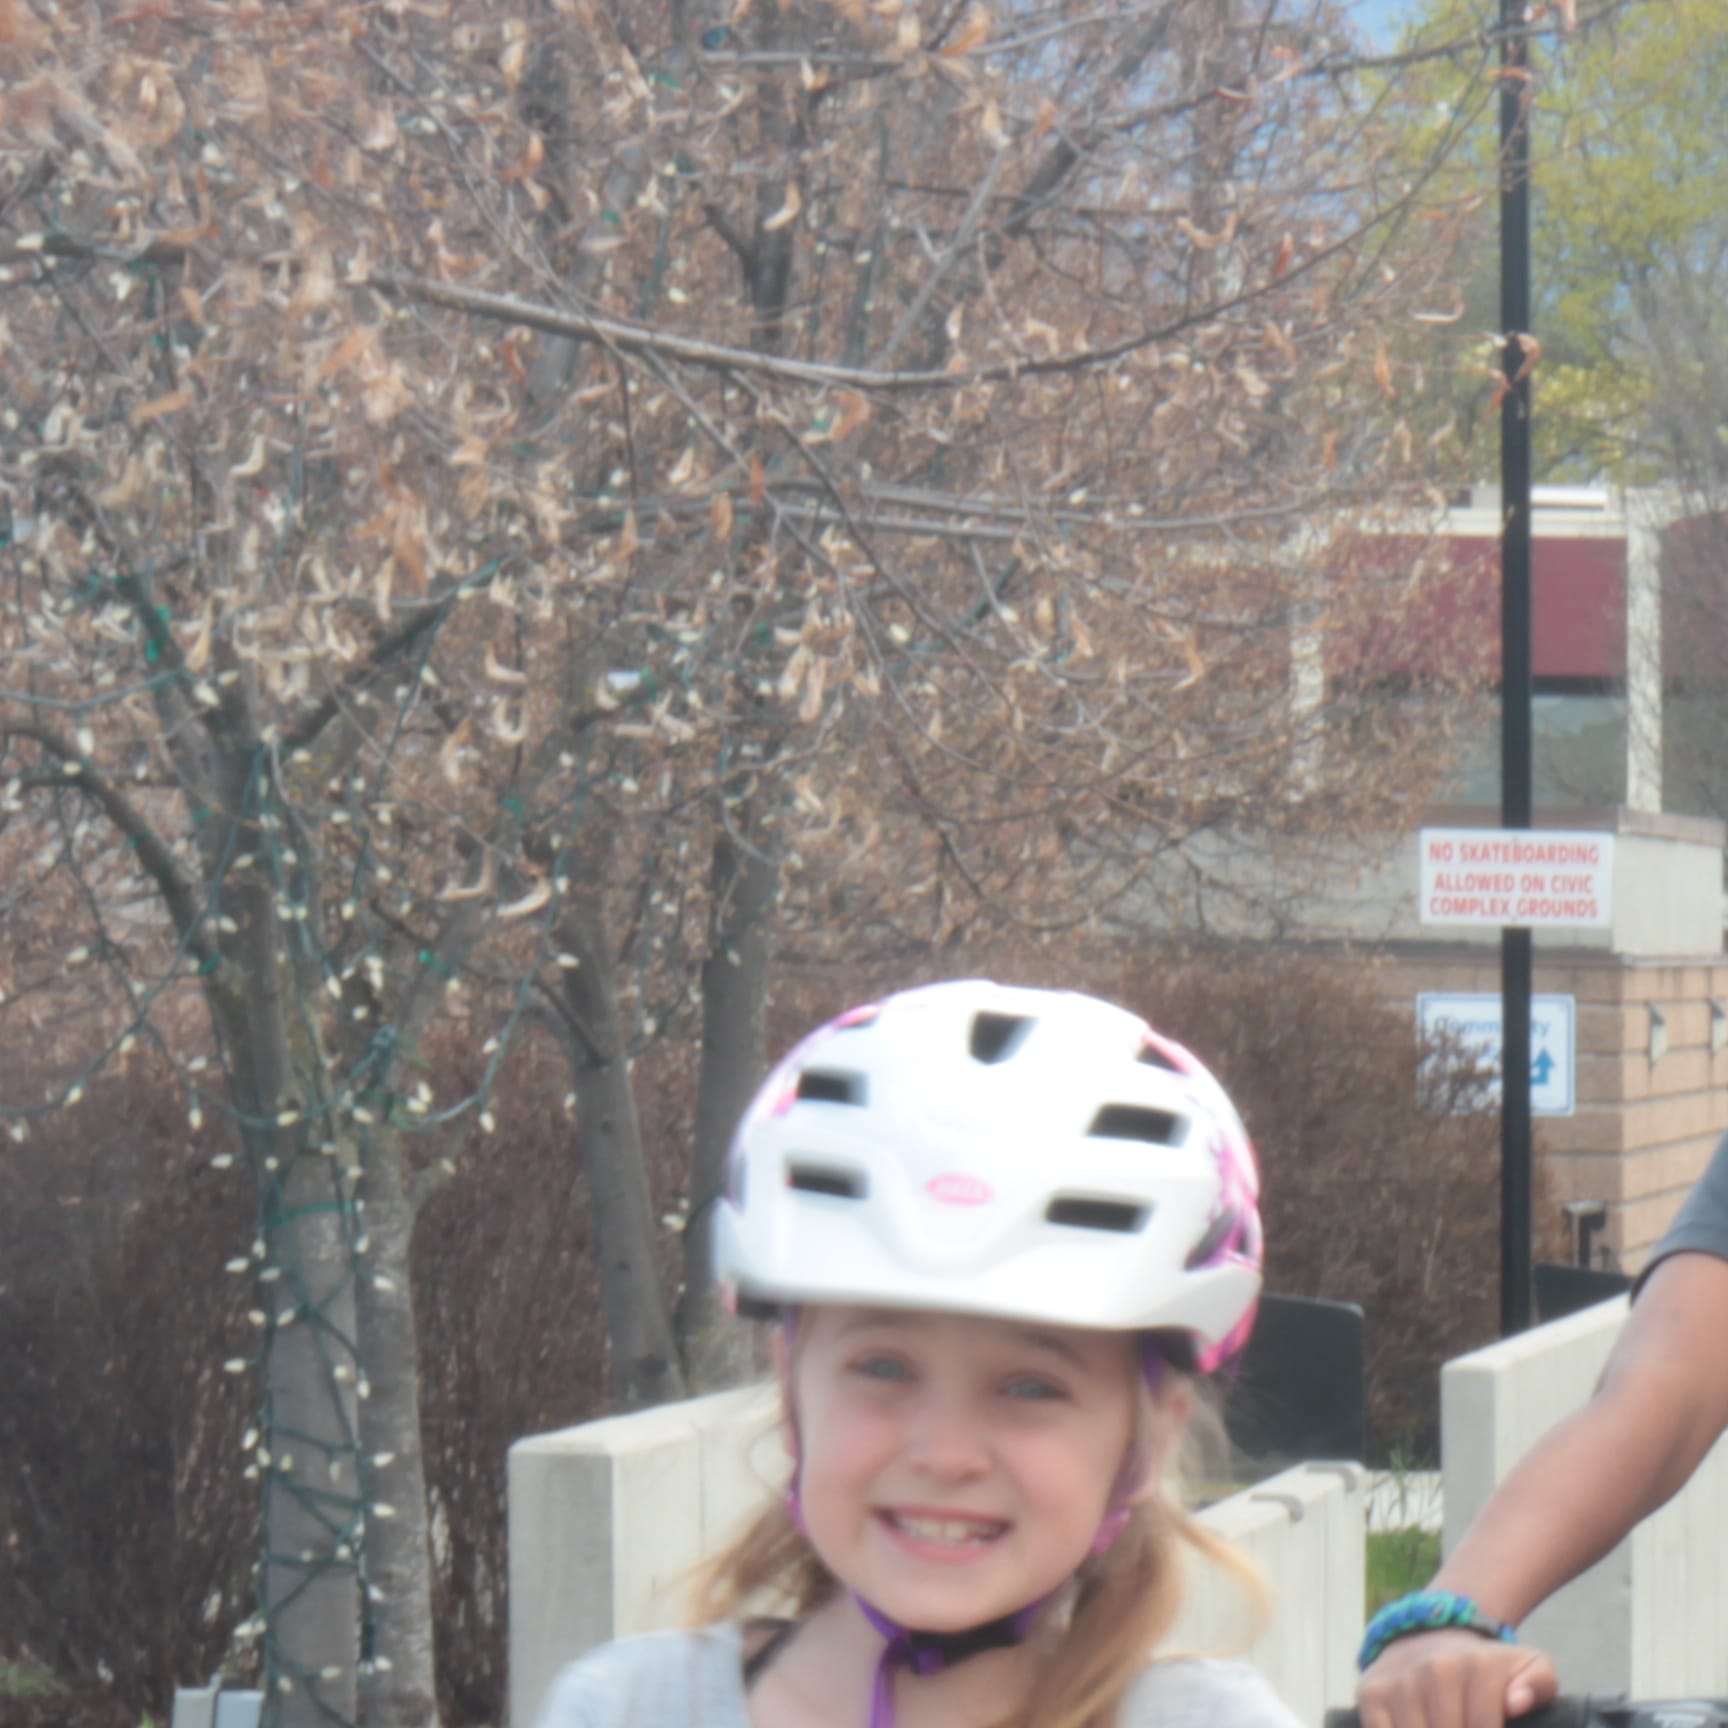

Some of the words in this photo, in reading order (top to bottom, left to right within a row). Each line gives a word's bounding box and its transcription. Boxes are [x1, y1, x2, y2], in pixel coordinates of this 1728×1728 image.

[1429, 842, 1454, 862] NO
[1460, 842, 1599, 865] SKATEBOARDING
[1434, 872, 1515, 892] ALLOWED
[1520, 873, 1545, 892] ON
[1551, 874, 1593, 894] CIVIC
[1429, 896, 1510, 916] COMPLEX
[1515, 897, 1599, 918] GROUNDS
